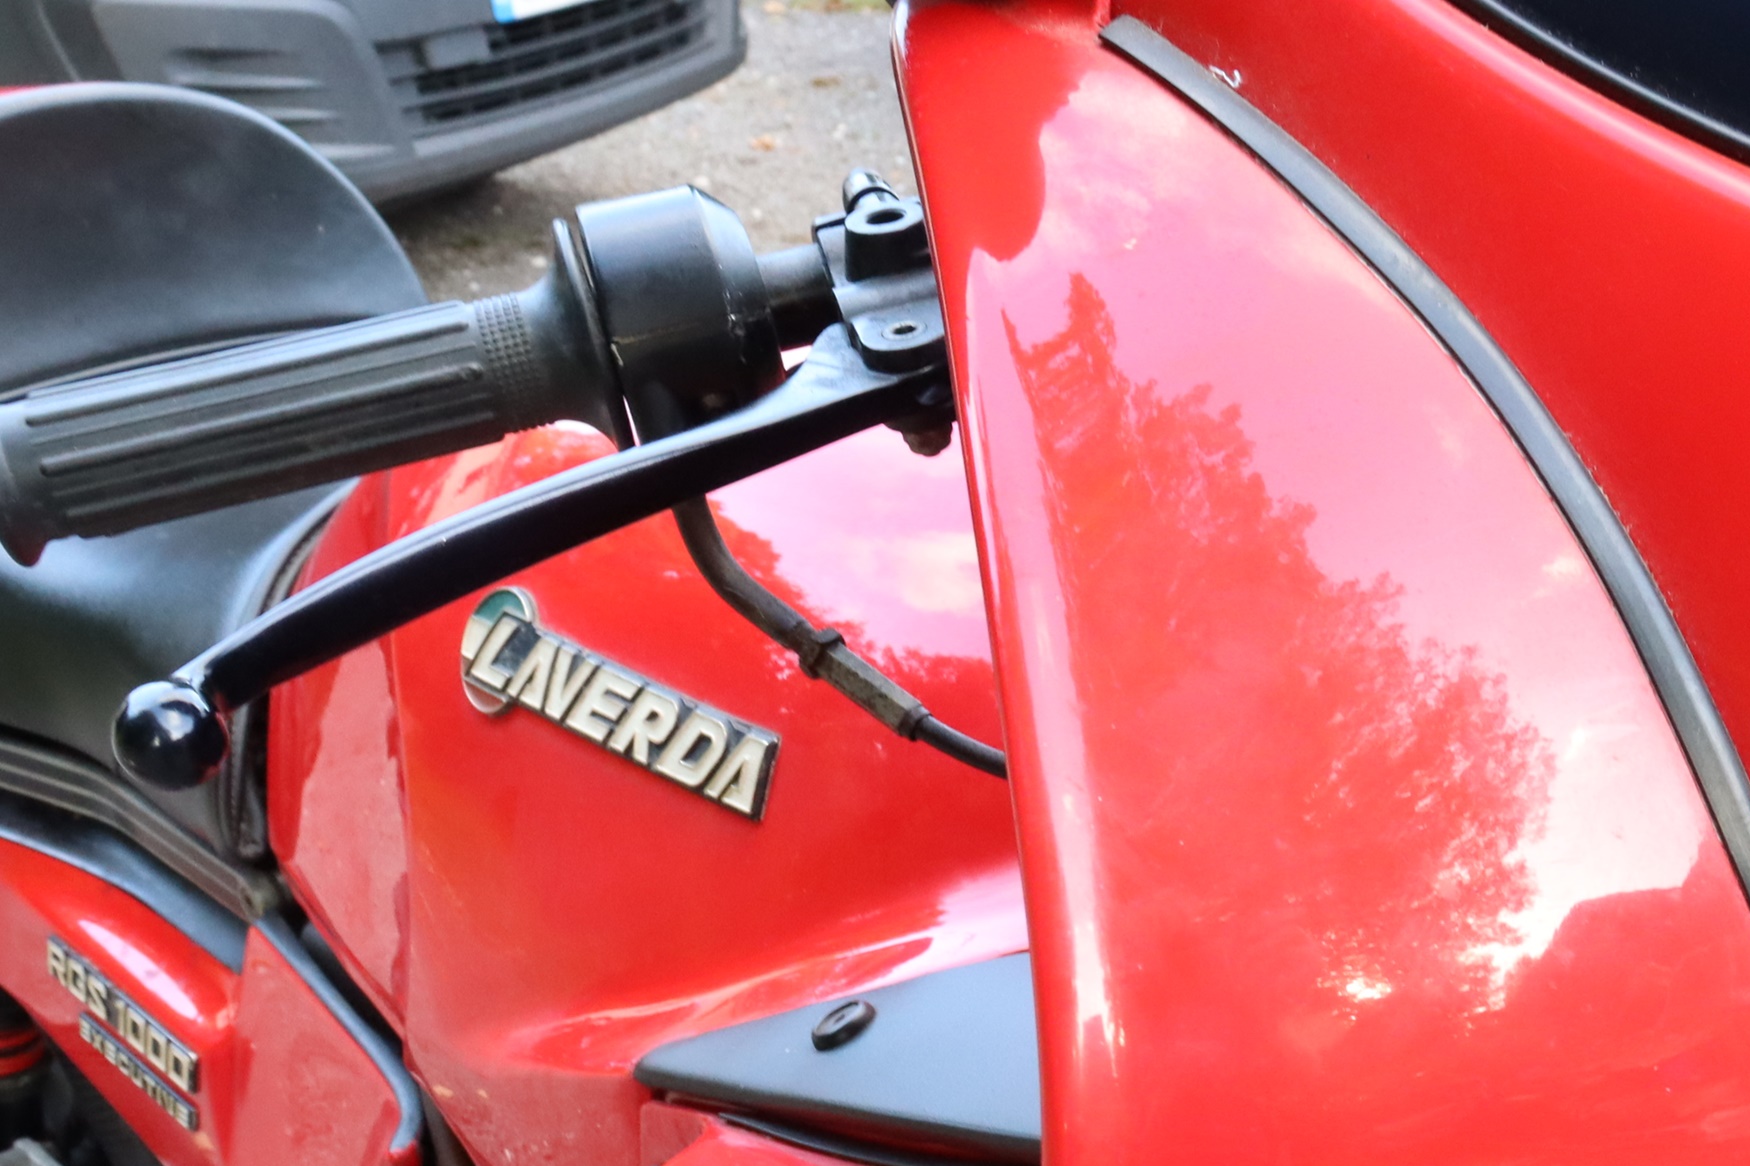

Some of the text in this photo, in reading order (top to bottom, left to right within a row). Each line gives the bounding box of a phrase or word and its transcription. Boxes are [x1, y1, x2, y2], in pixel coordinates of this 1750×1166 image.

[468, 615, 772, 815] LAVERDA
[47, 938, 193, 1092] RGS 1000
